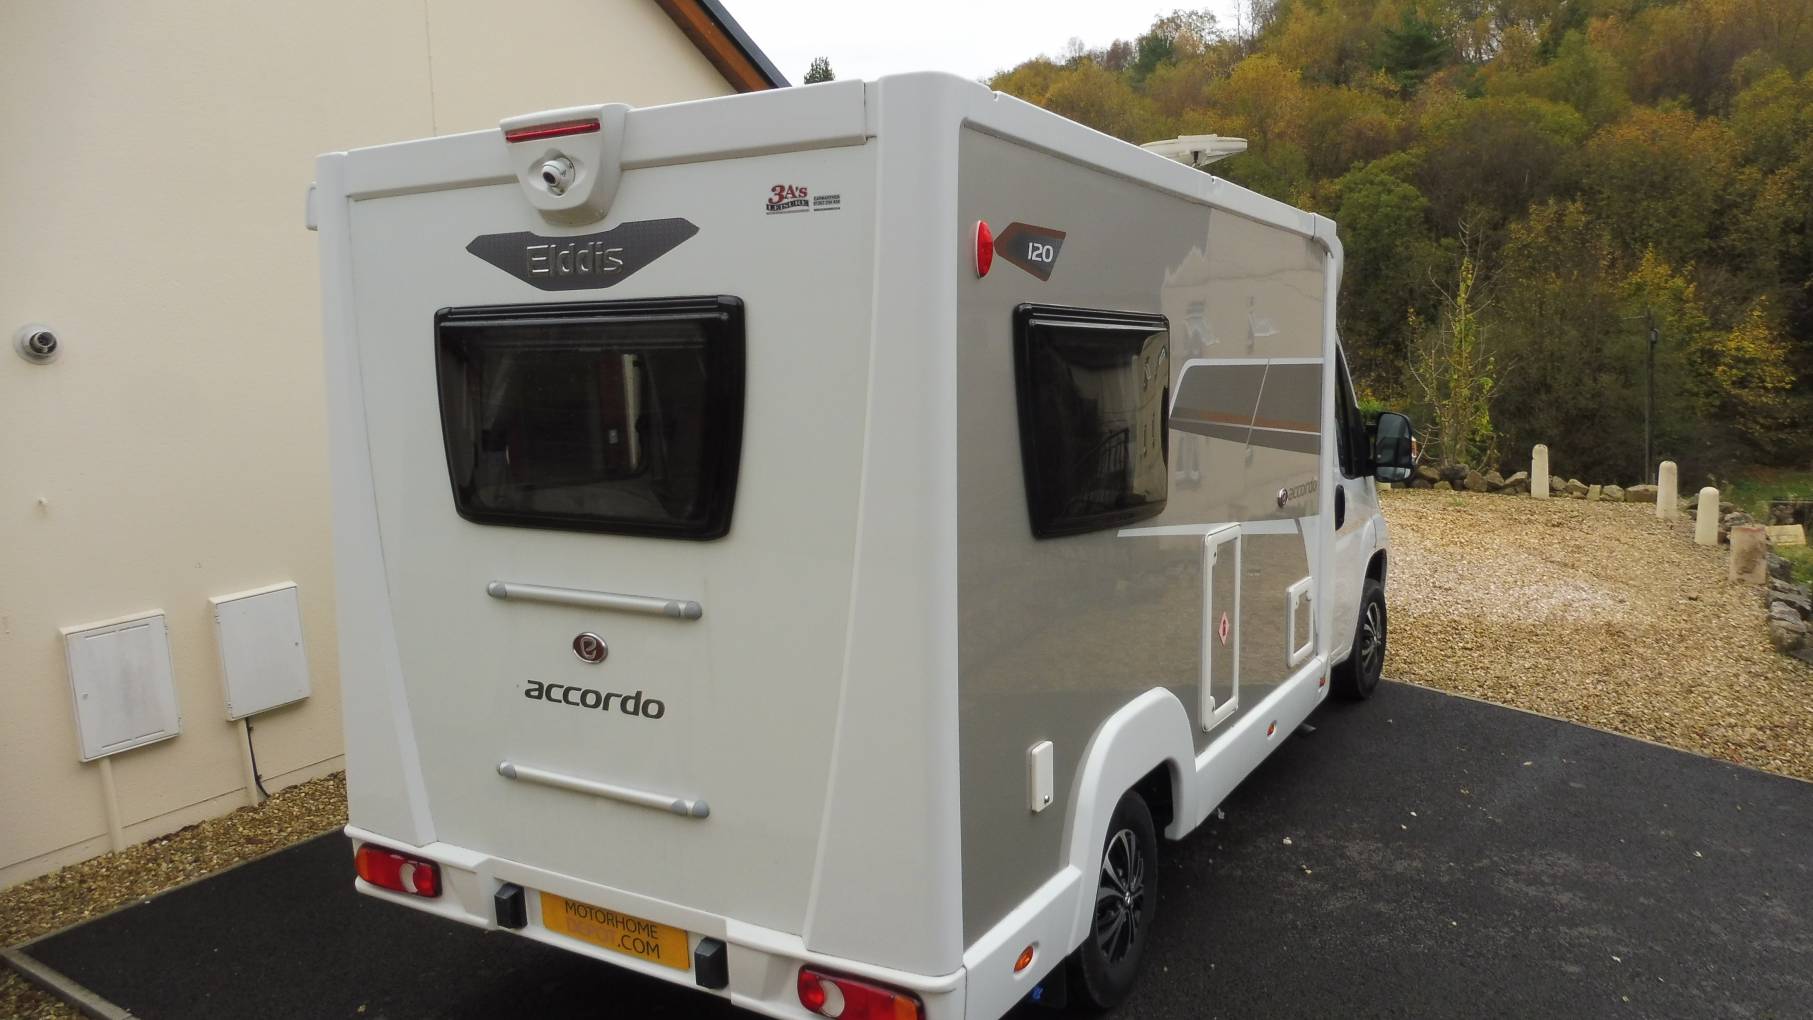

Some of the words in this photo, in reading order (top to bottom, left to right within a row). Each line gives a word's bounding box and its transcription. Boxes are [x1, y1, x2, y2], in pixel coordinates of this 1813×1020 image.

[768, 184, 808, 204] 3A's
[527, 241, 624, 275] Elddis
[1027, 242, 1054, 262] 120
[524, 679, 666, 720] accordo
[564, 900, 659, 940] MOTORHOME
